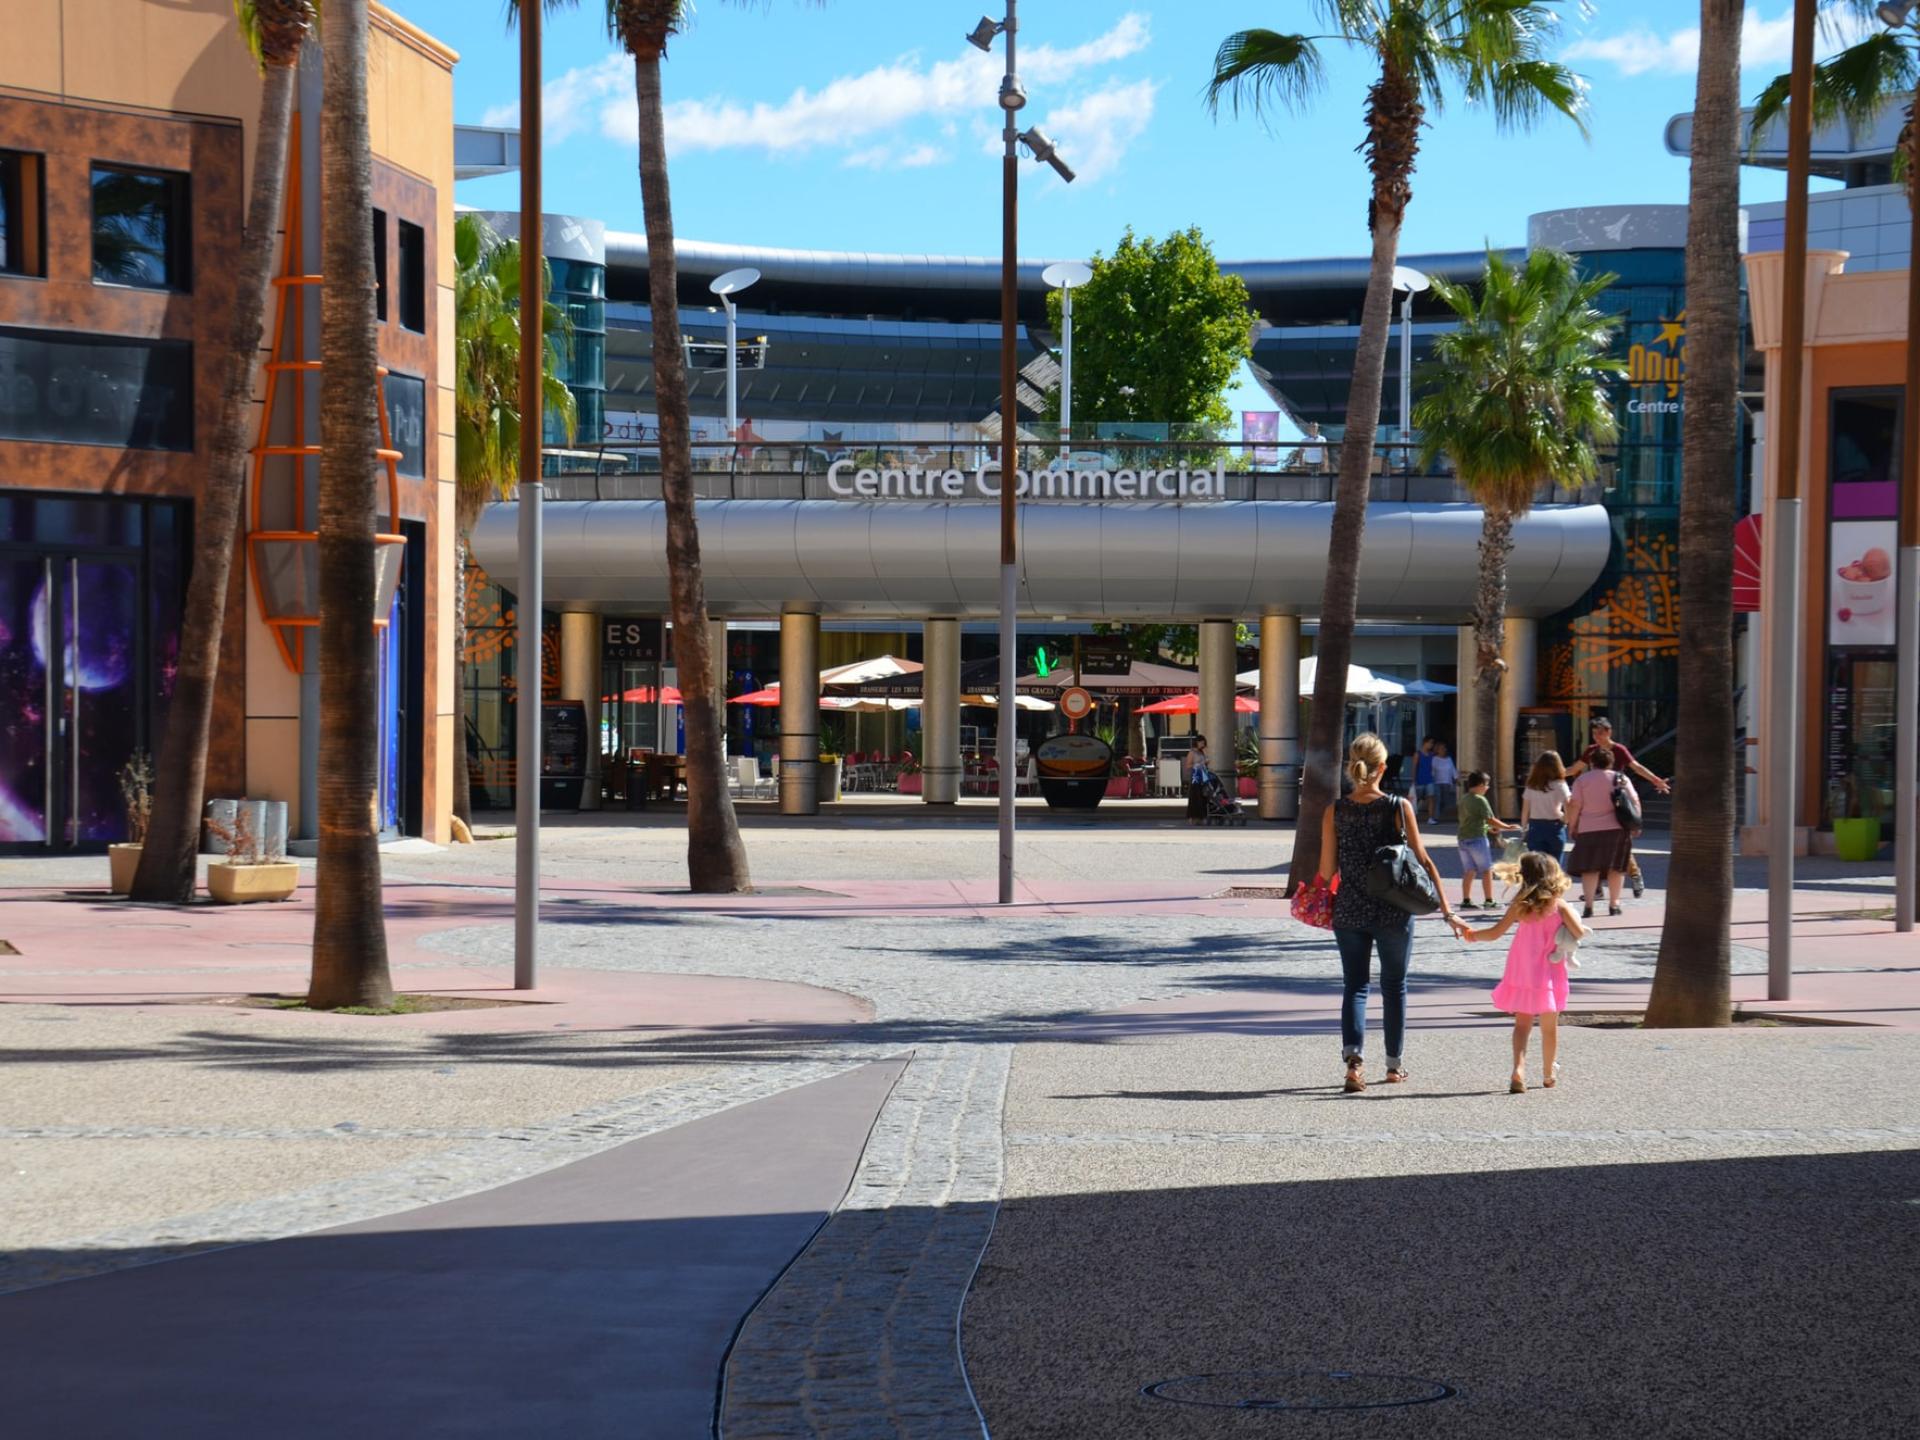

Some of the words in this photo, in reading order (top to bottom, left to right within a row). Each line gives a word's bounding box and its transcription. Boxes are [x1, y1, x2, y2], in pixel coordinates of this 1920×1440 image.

[1627, 399, 1679, 414] Centre
[826, 458, 965, 496] Centre
[976, 457, 1226, 497] Commercial
[607, 624, 641, 645] ES
